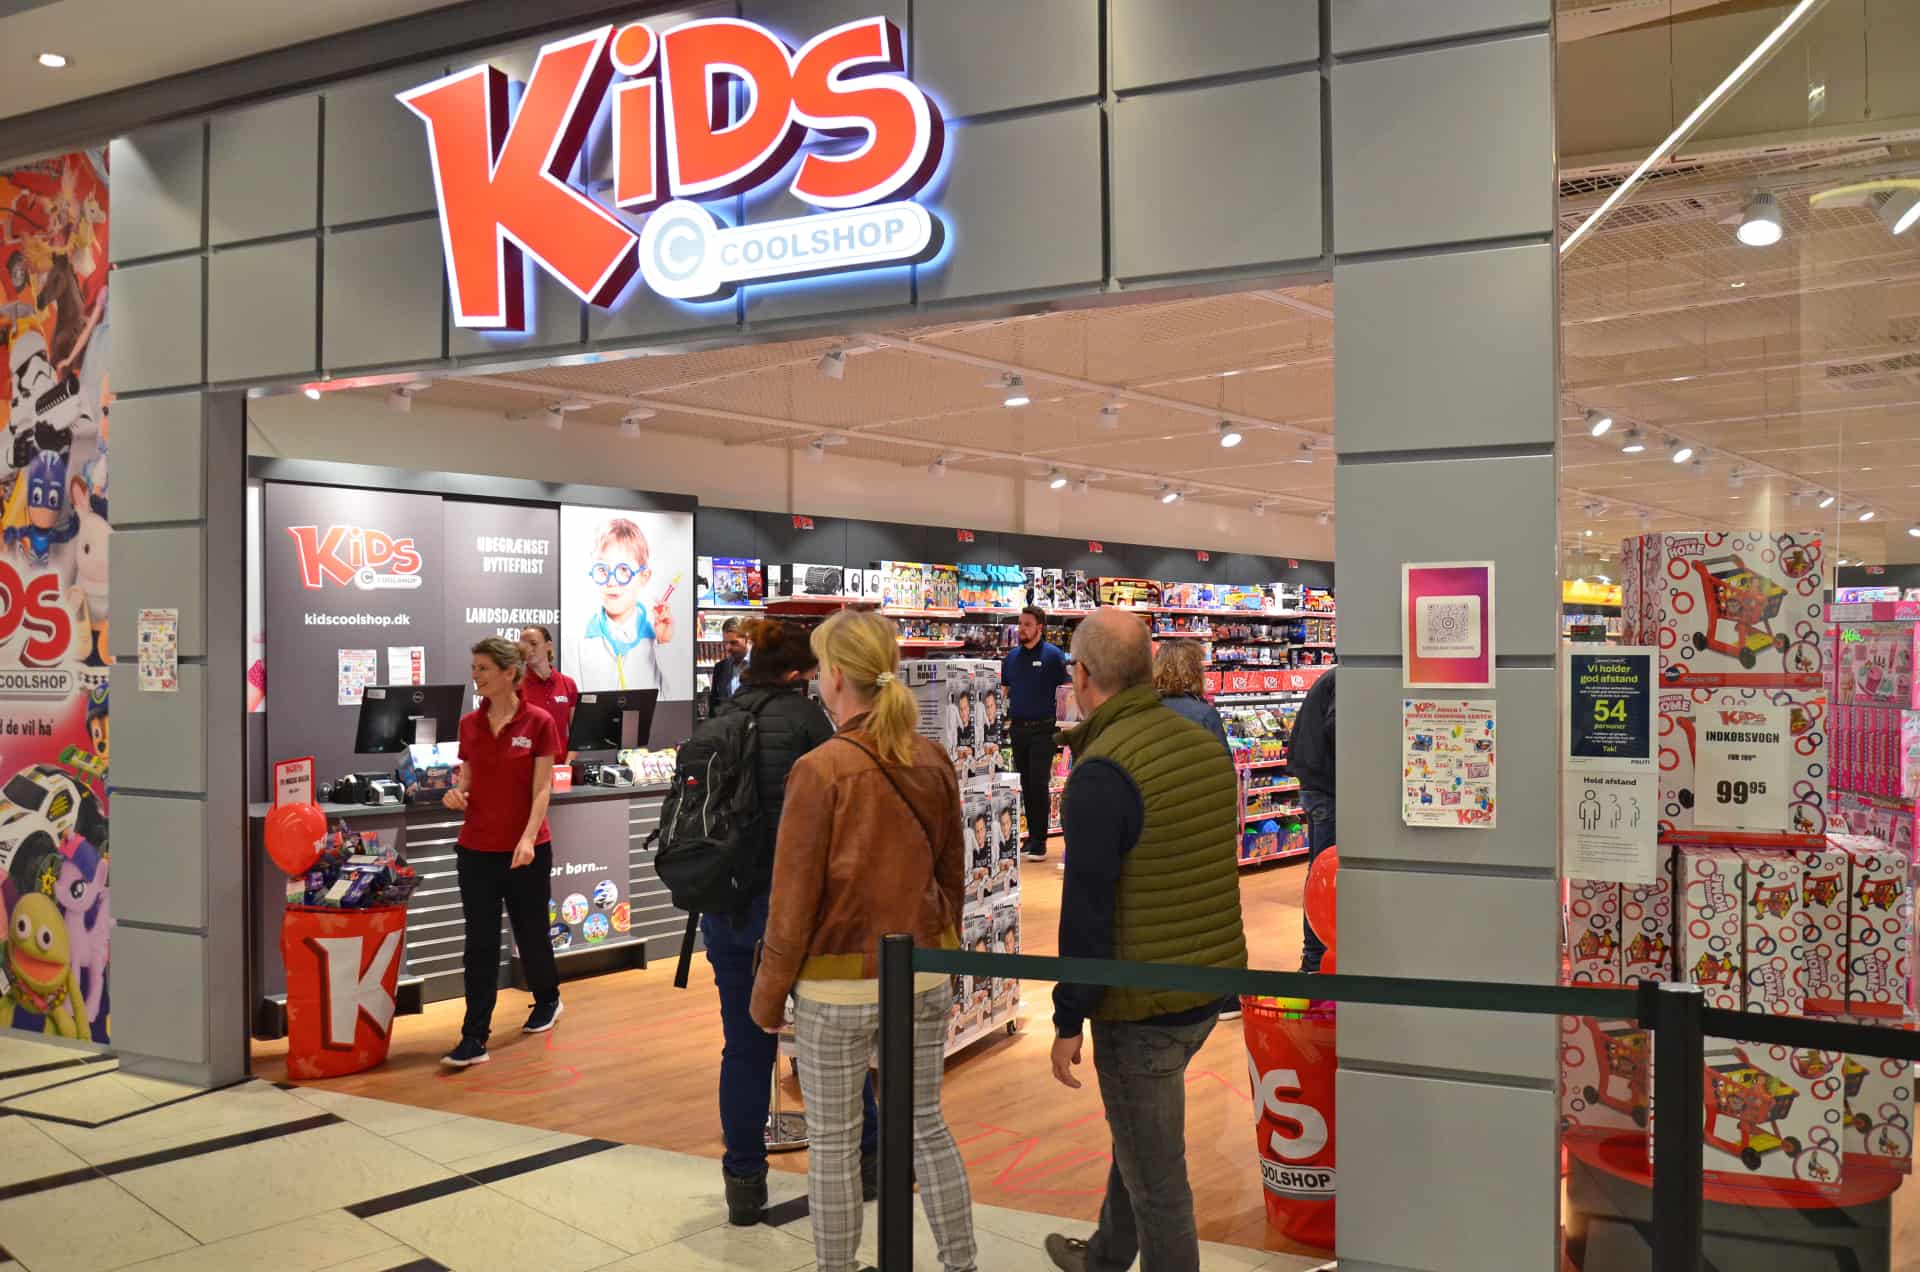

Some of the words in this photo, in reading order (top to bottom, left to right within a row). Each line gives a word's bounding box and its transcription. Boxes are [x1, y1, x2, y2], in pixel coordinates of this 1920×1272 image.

[720, 217, 905, 267] COOLSHOP
[477, 536, 549, 555] UBEGRÆNSET
[1667, 544, 1705, 559] HOME
[483, 556, 544, 575] BYTTEFRIST
[304, 613, 411, 628] kidscoolshop.dk
[465, 607, 560, 625] LANDSDÆKKENDE
[497, 627, 522, 643] KÆD
[1599, 663, 1632, 673] holder
[1580, 675, 1600, 685] god
[1601, 674, 1638, 684] afstand
[1593, 699, 1628, 721] 54
[1660, 699, 1691, 712] OME
[6, 722, 19, 736] de
[22, 722, 35, 736] vil
[1706, 730, 1780, 743] INDKØBSVOGN
[1584, 776, 1603, 785] Hold
[1605, 777, 1637, 786] afstand
[1261, 1165, 1331, 1188] OOLSHOP
